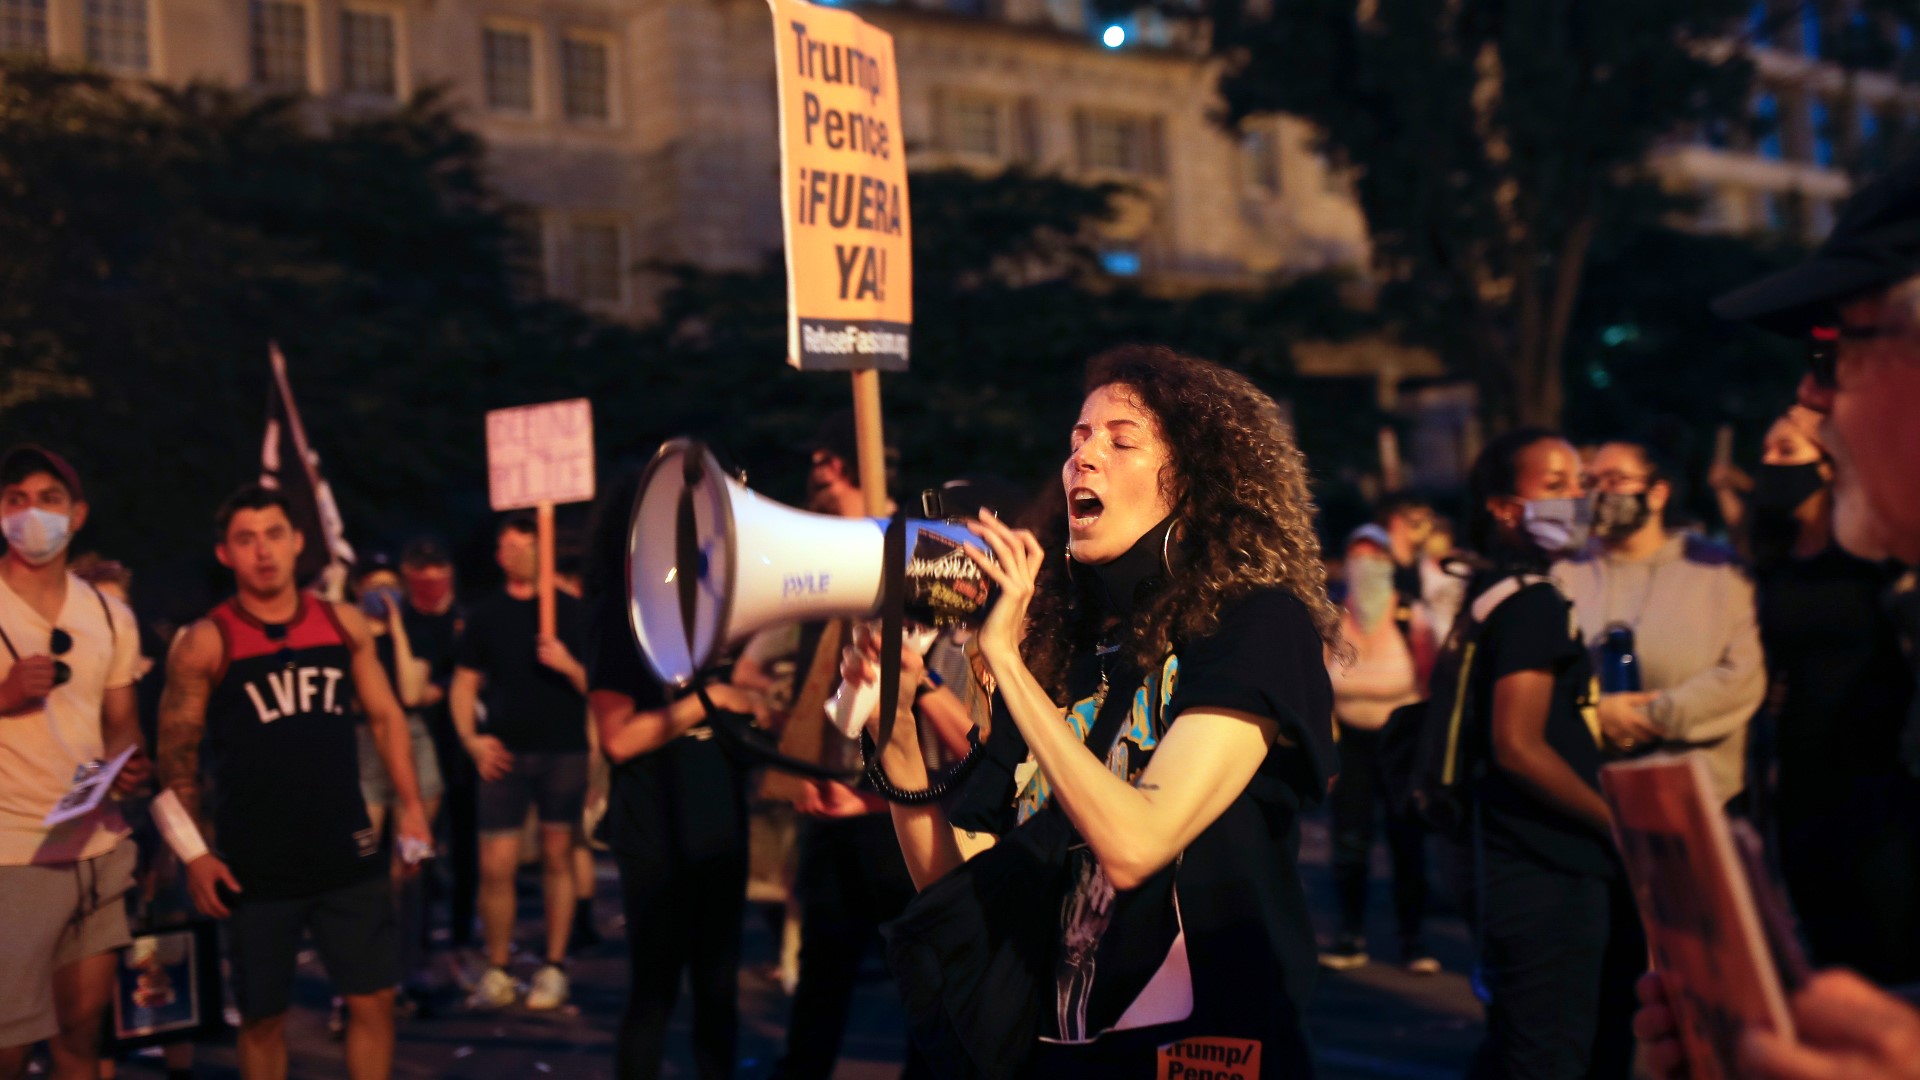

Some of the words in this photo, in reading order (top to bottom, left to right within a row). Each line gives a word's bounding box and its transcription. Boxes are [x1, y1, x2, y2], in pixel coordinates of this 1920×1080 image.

[804, 90, 889, 160] Pence
[835, 244, 887, 301] YA!
[1168, 1060, 1245, 1080] Pence
